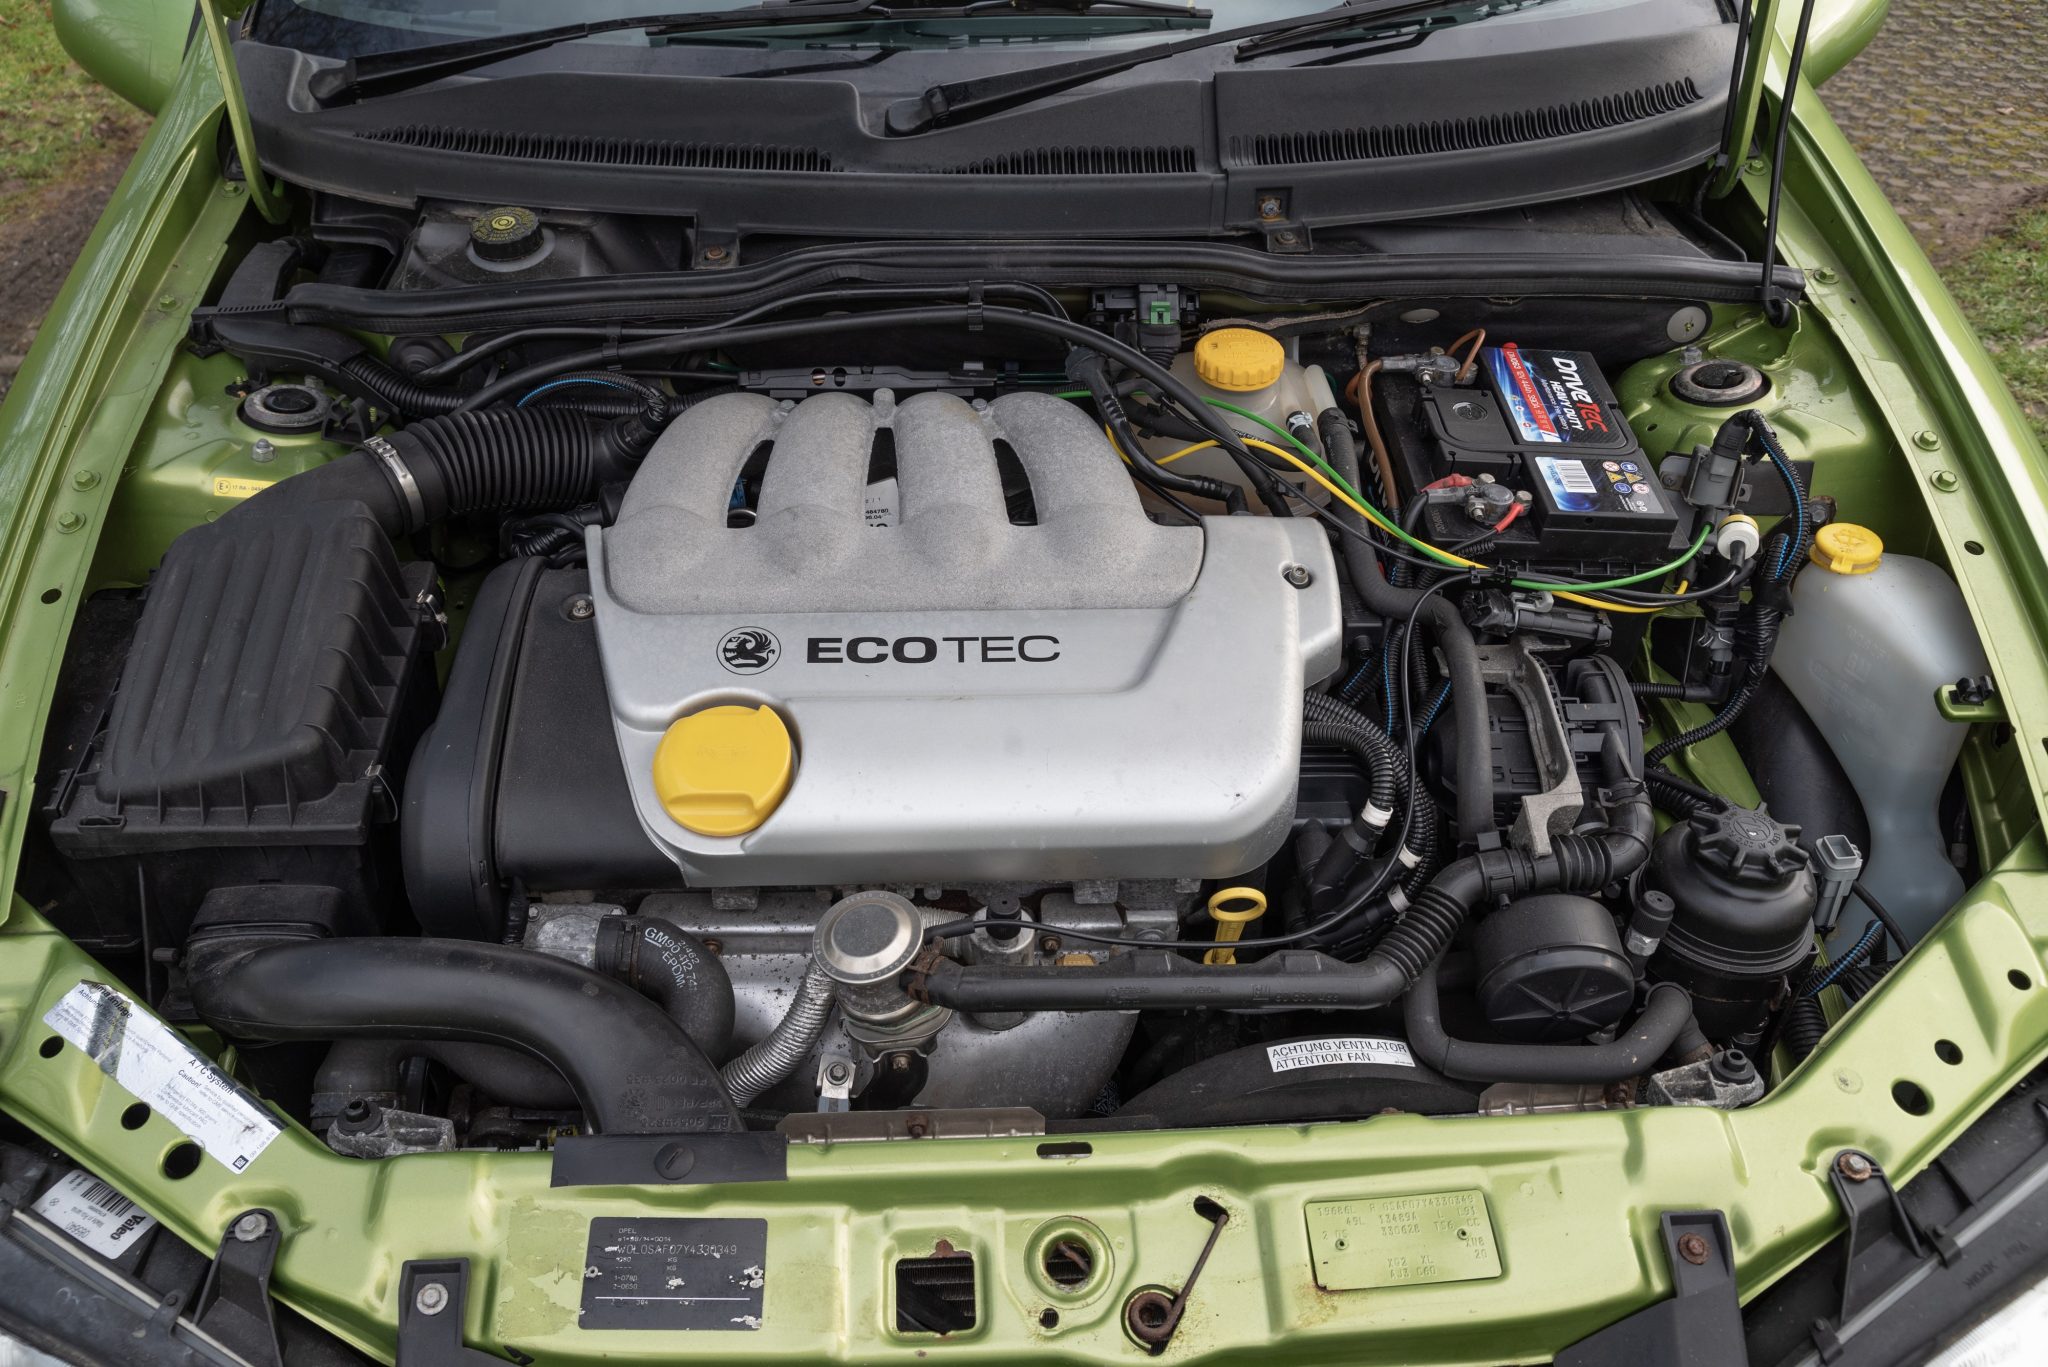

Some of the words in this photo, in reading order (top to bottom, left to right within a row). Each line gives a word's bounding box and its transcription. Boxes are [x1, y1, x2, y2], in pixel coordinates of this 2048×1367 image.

[1549, 381, 1572, 406] HEAVY
[1563, 408, 1583, 430] DUTY
[807, 635, 1061, 664] ECOTEC
[1272, 1041, 1332, 1058] ACHTUNG
[1333, 1040, 1407, 1053] VENTILATOR
[1276, 1053, 1343, 1070] ATTENTION
[1347, 1053, 1371, 1062] FAN
[177, 1068, 202, 1089] Caution!
[205, 1071, 235, 1096] System
[109, 1214, 146, 1241] Valeo
